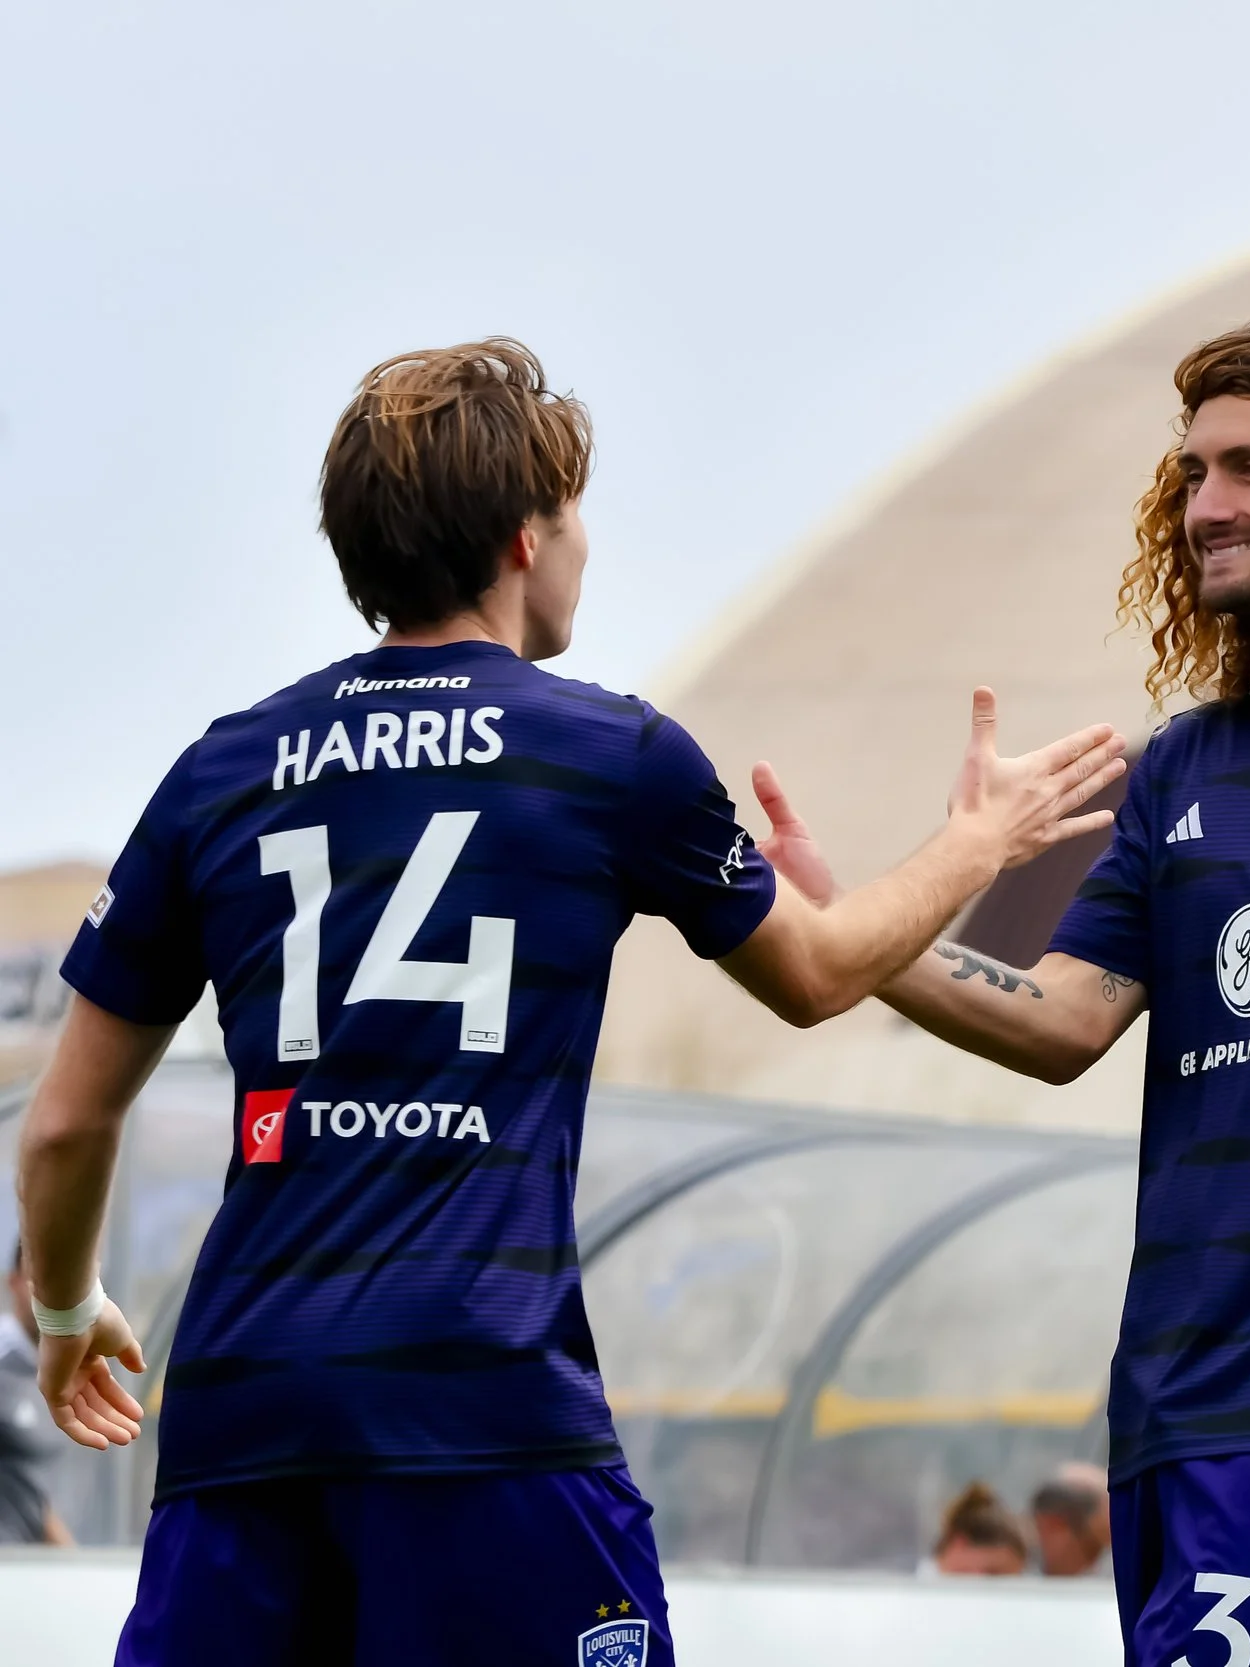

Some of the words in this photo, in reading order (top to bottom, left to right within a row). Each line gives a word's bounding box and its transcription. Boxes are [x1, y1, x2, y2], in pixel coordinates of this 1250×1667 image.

[334, 676, 471, 699] Humana
[272, 706, 505, 790] HARRIS
[257, 811, 516, 1062] 14
[1180, 1051, 1197, 1077] GE
[301, 1100, 491, 1143] TOYOTA
[586, 1629, 642, 1657] LOUISVILLE
[605, 1645, 624, 1657] CITY
